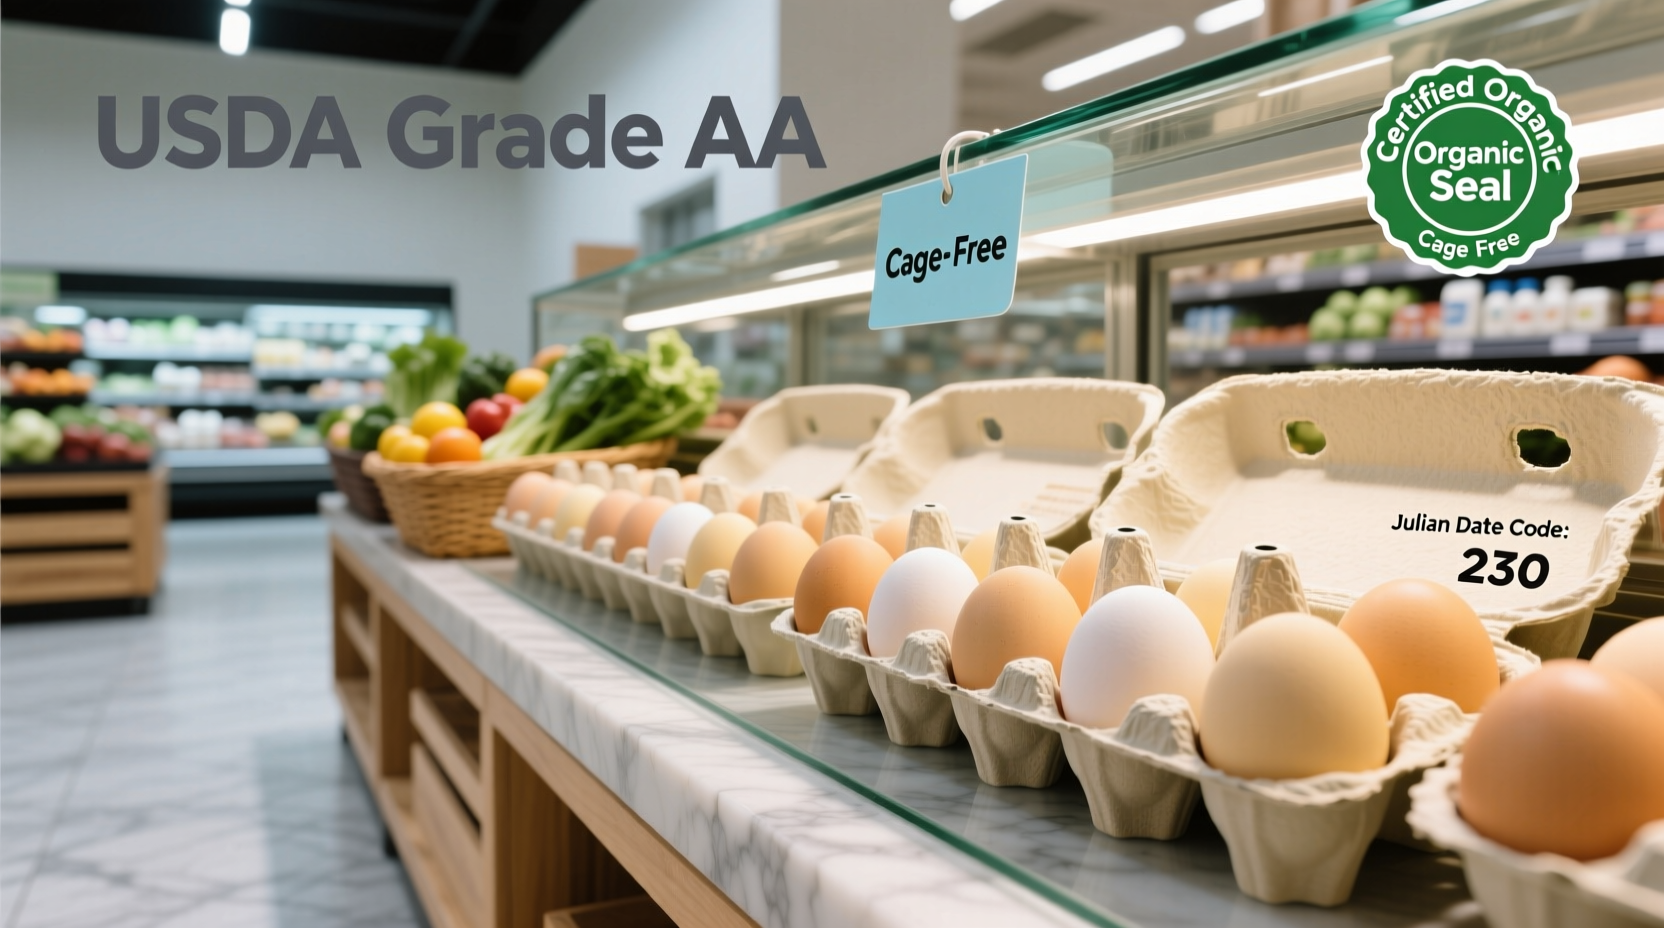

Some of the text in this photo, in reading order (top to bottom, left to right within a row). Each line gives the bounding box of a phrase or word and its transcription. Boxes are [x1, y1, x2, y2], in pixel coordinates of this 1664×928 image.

[885, 234, 1007, 284] Cage-Free
[1391, 513, 1569, 539] Julian Date Code:
[1457, 547, 1550, 590] 230
